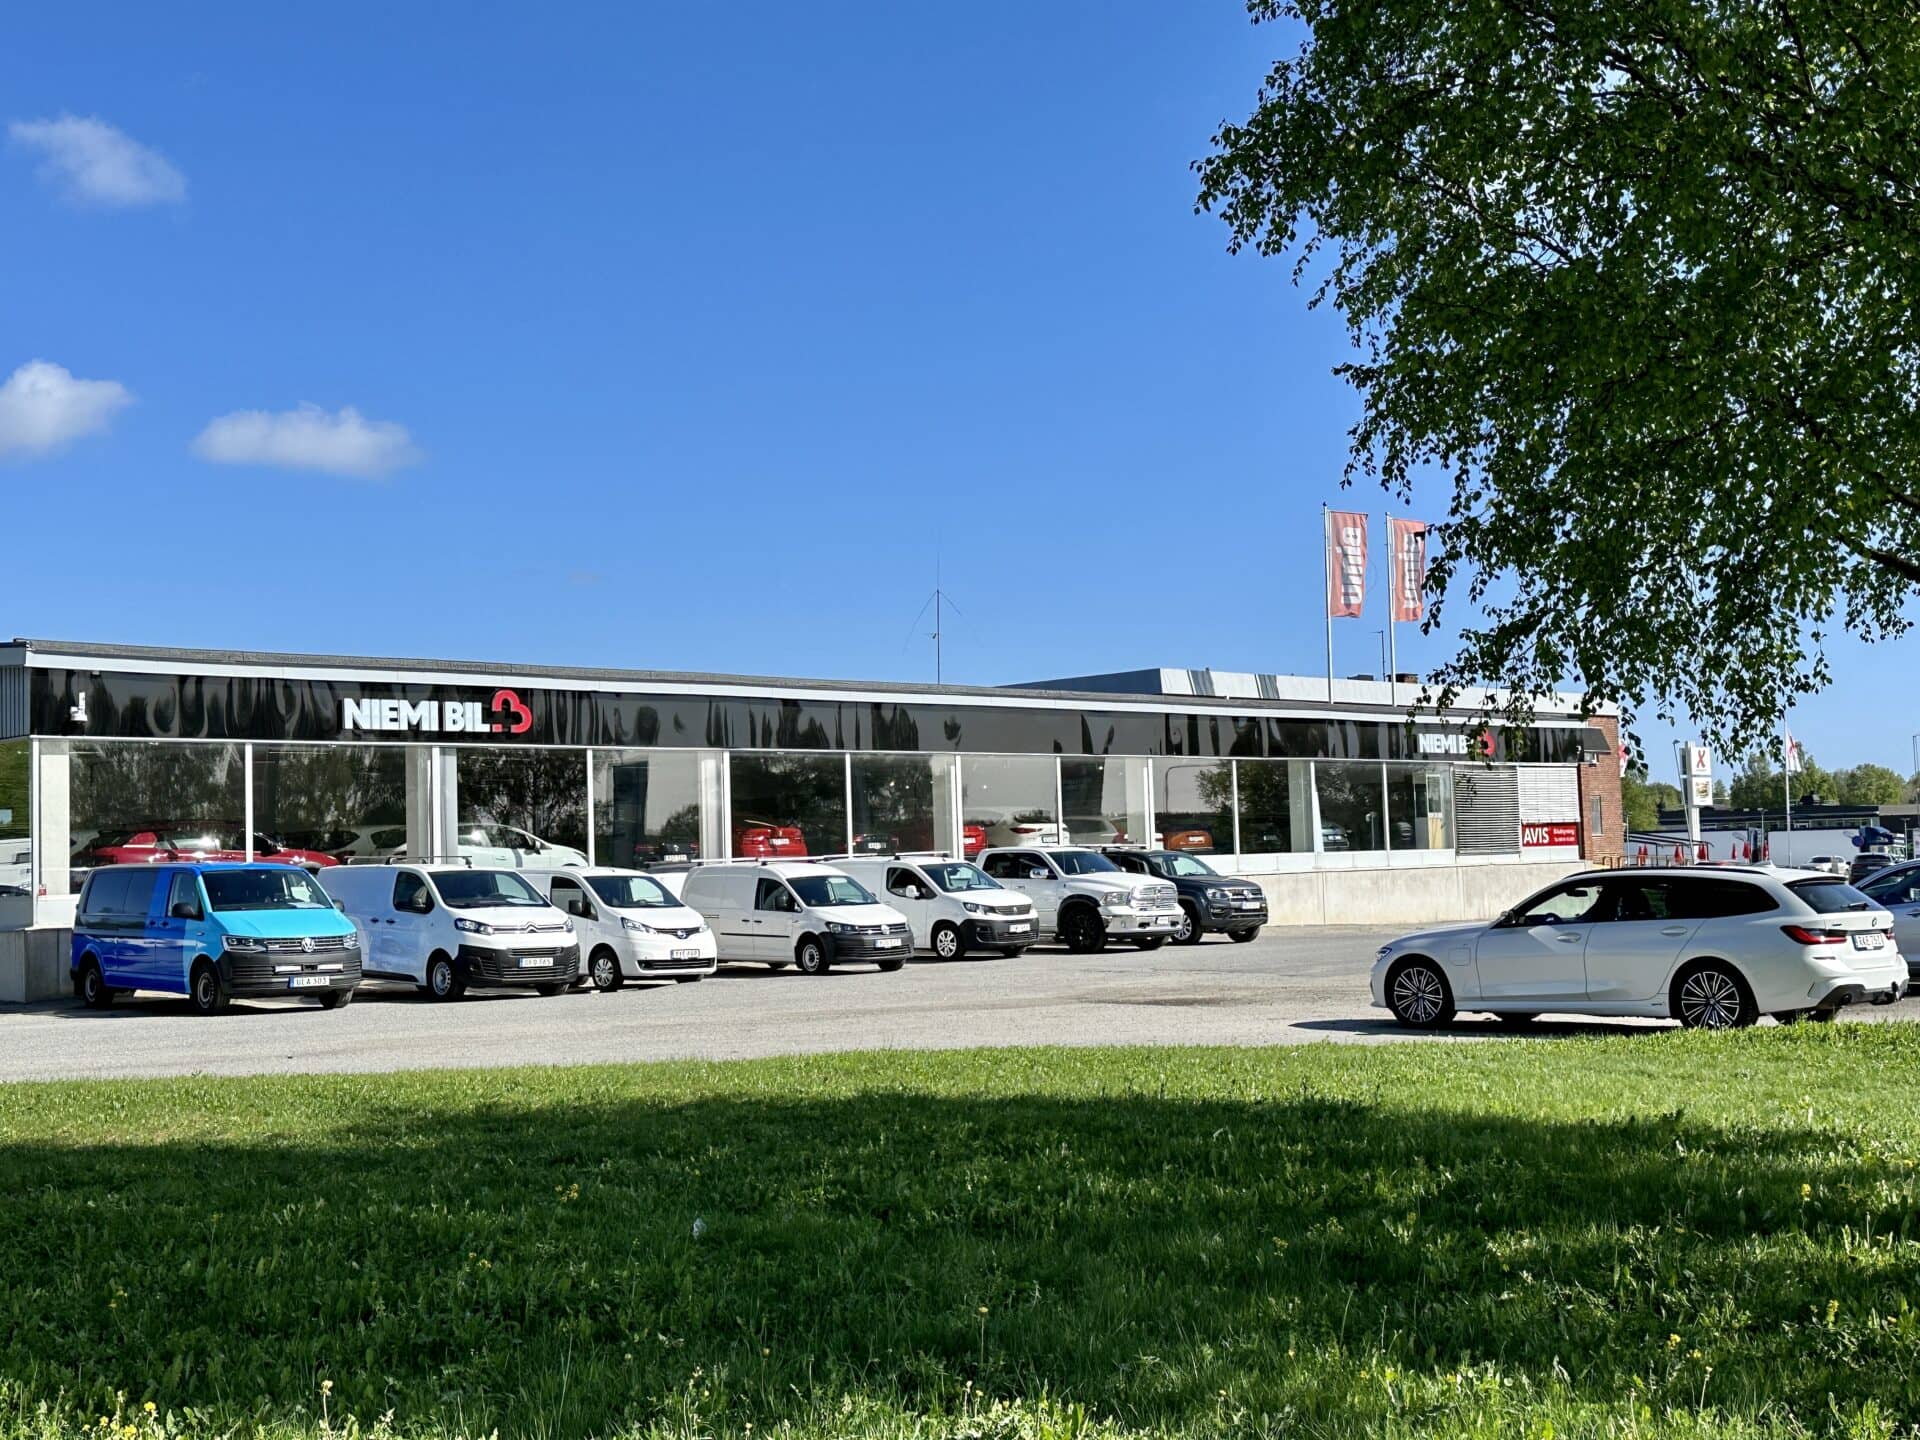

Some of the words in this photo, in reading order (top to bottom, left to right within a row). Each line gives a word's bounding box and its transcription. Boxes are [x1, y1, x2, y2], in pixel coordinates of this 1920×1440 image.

[343, 697, 439, 732] NIEMI
[442, 701, 491, 733] BIL
[1418, 733, 1457, 754] NIEMI
[1523, 826, 1550, 845] AVIS
